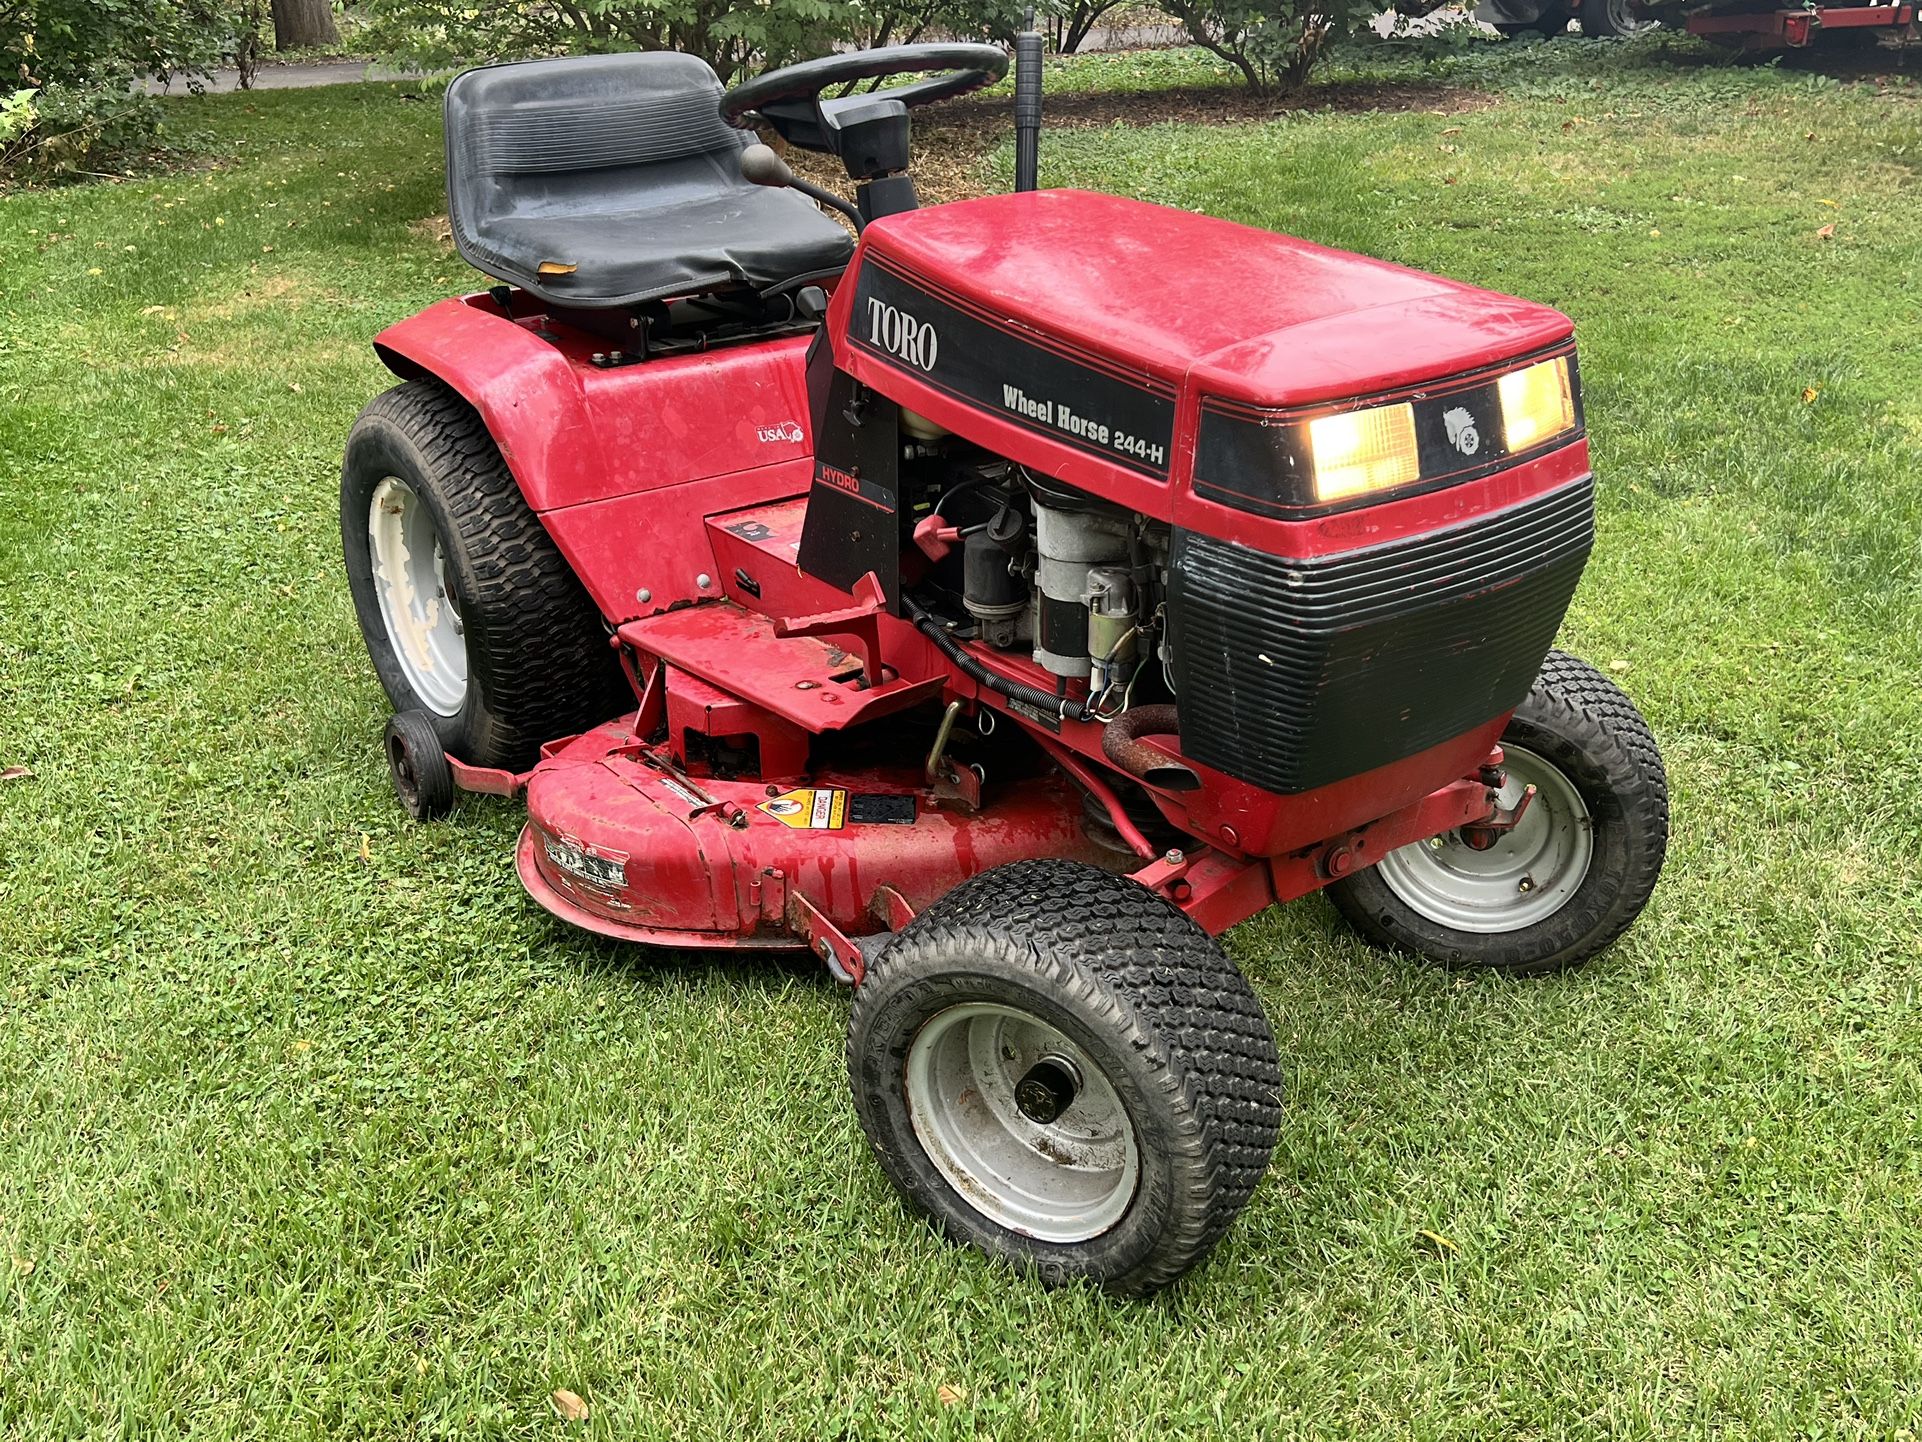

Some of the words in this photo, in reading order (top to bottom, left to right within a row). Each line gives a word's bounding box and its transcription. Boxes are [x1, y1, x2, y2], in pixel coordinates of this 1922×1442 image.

[868, 296, 938, 371] TORO
[757, 429, 788, 442] USA
[1003, 384, 1053, 425] Wheel
[1057, 403, 1110, 444] Horse
[1113, 431, 1164, 465] 244-H
[822, 465, 860, 492] HYDRO
[815, 796, 828, 820] DANGER
[865, 980, 940, 1060] KENDA
